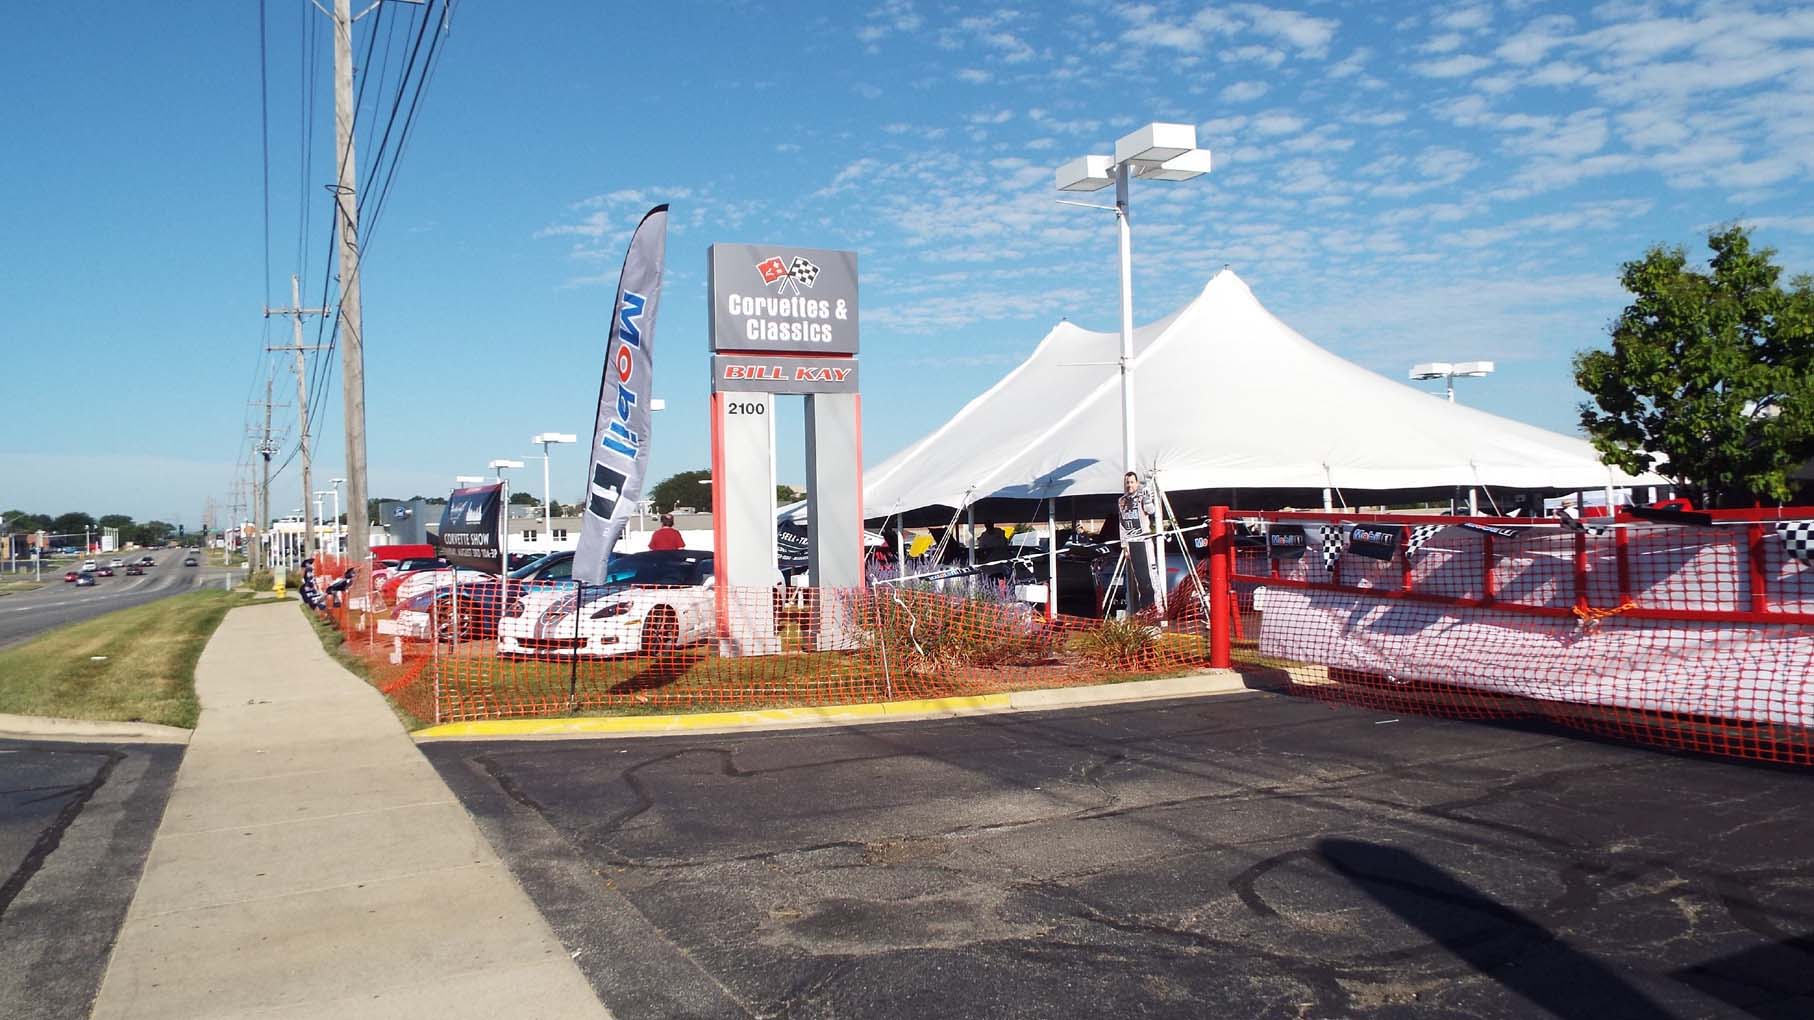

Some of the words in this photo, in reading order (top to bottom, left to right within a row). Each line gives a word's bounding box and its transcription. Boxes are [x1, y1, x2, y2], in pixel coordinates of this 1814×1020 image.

[728, 293, 830, 319] Corvettes
[835, 298, 848, 320] &
[746, 318, 832, 342] Classics
[601, 288, 646, 461] Mobil
[723, 364, 789, 380] BILL
[794, 366, 852, 382] KAY
[728, 402, 765, 415] 2100
[444, 532, 470, 546] CORVETTE
[470, 532, 489, 546] SHOW
[781, 531, 797, 543] SELL
[1271, 534, 1294, 546] Mobil
[1353, 528, 1382, 544] Mobil
